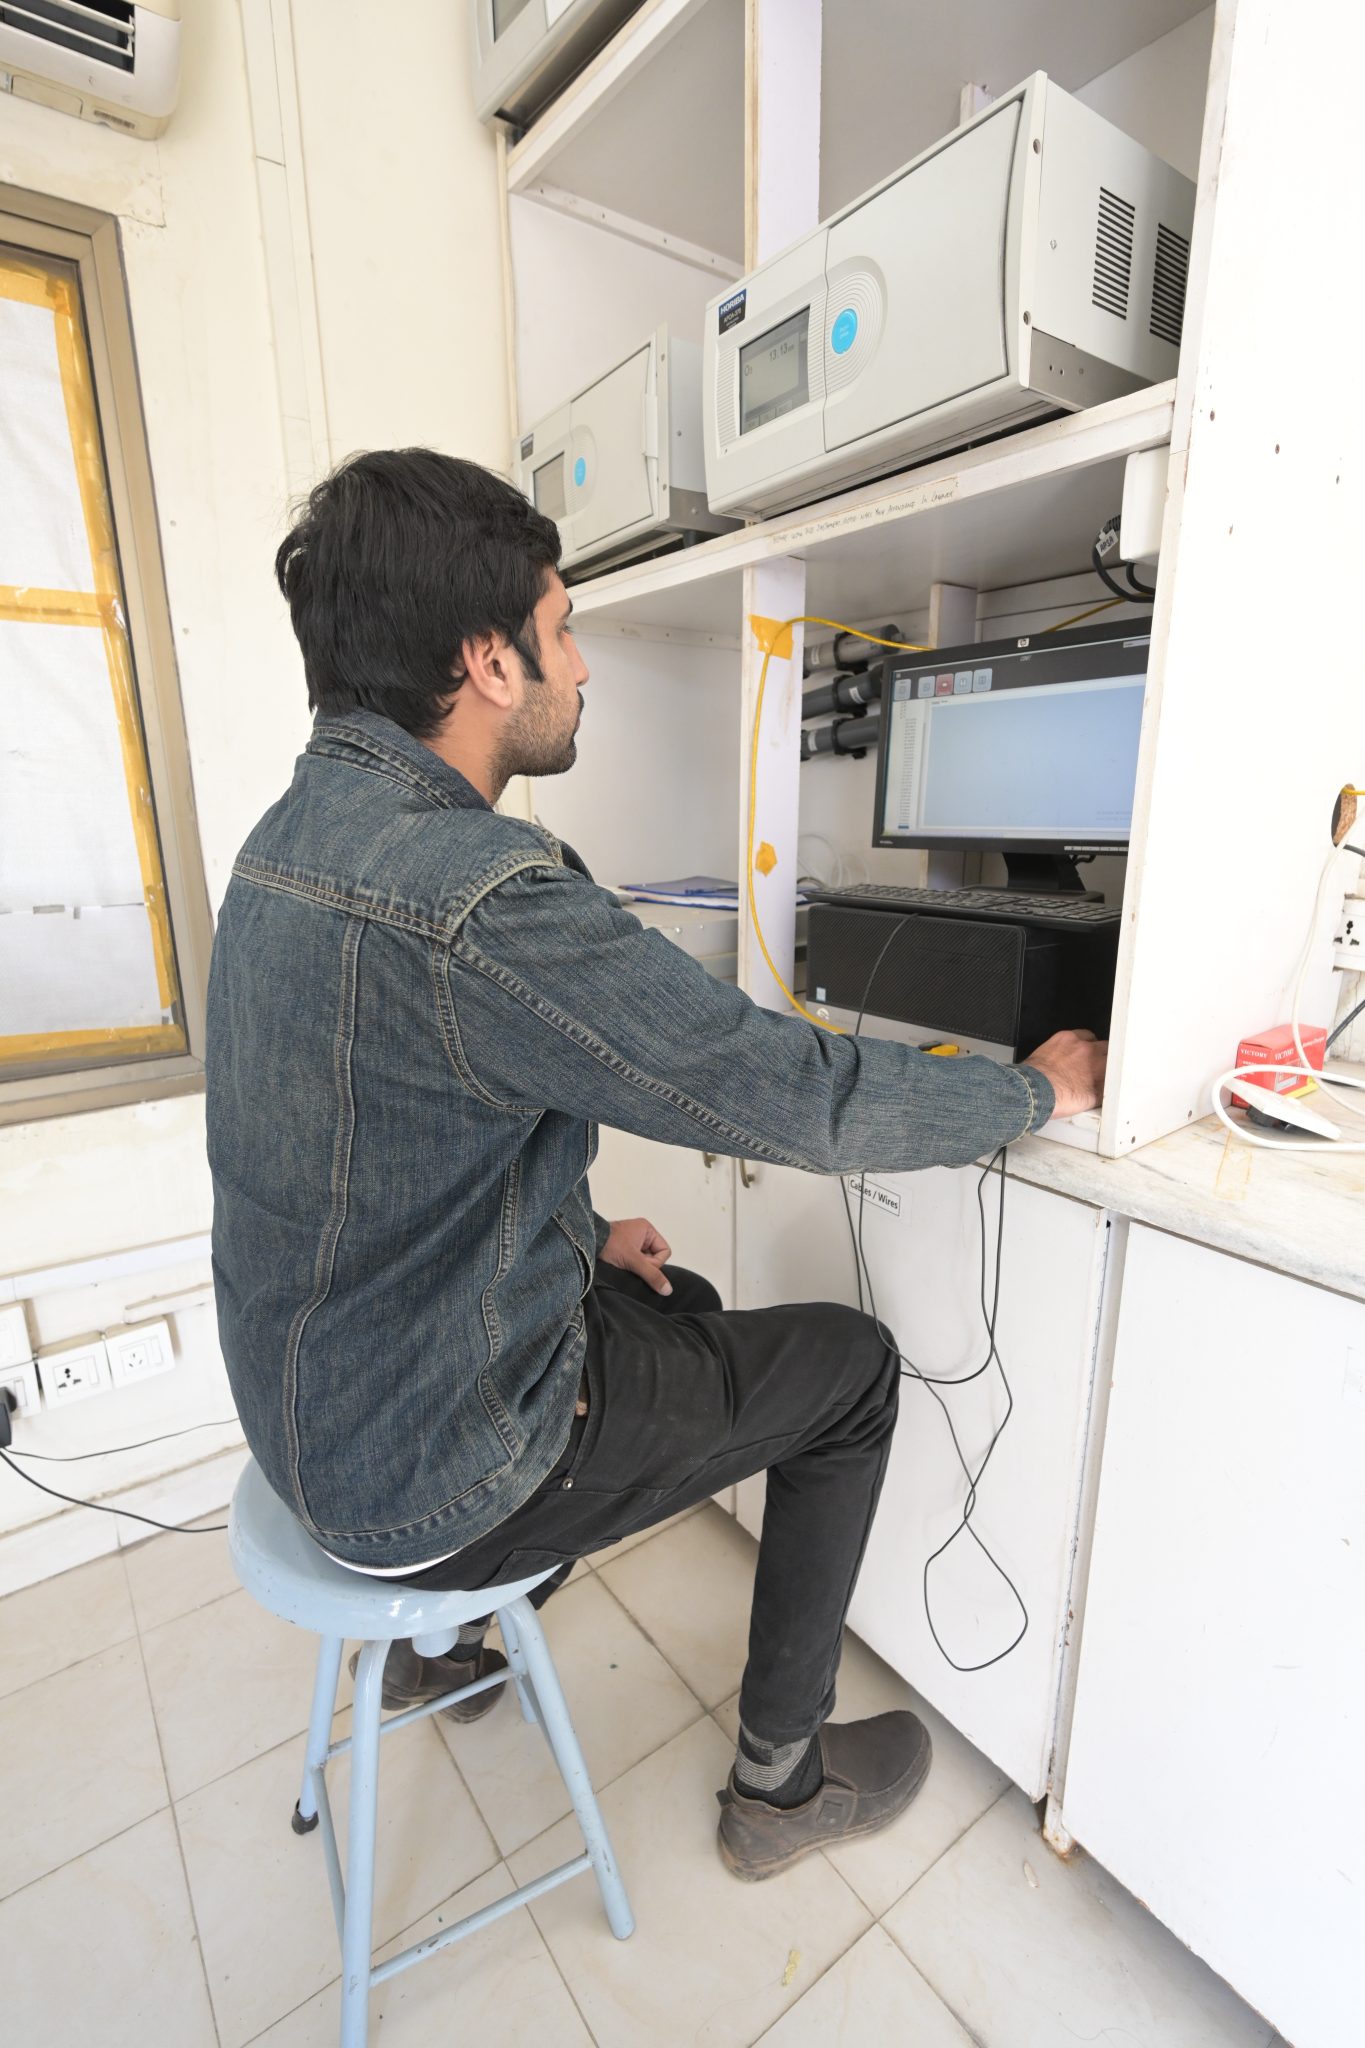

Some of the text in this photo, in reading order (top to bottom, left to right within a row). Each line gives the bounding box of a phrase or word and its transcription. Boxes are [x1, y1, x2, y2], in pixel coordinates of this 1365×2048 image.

[720, 293, 744, 315] HORIBA
[850, 1179, 872, 1197] Cabes
[878, 1193, 898, 1209] Wires
